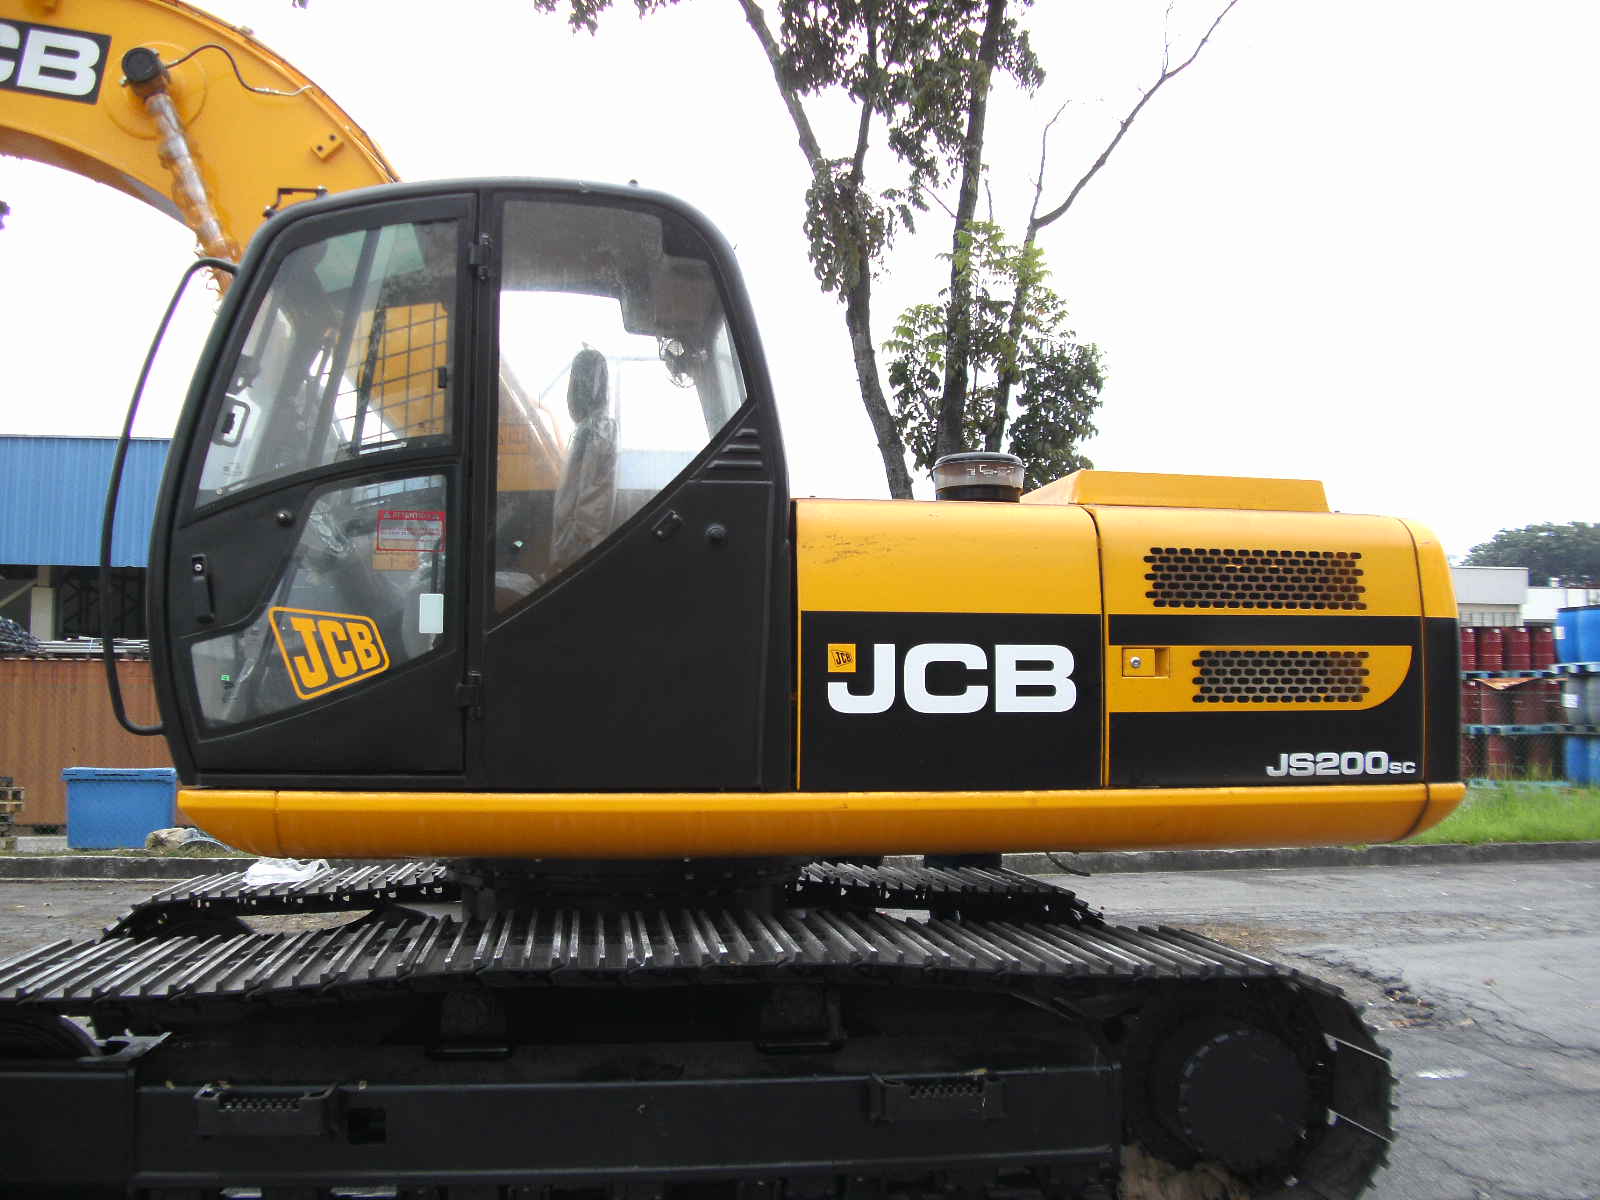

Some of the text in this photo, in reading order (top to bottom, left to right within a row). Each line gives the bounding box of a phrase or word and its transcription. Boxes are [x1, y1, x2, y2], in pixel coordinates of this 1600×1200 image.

[0, 23, 100, 96] B
[290, 616, 381, 689] JCB
[827, 643, 1077, 714] JCB
